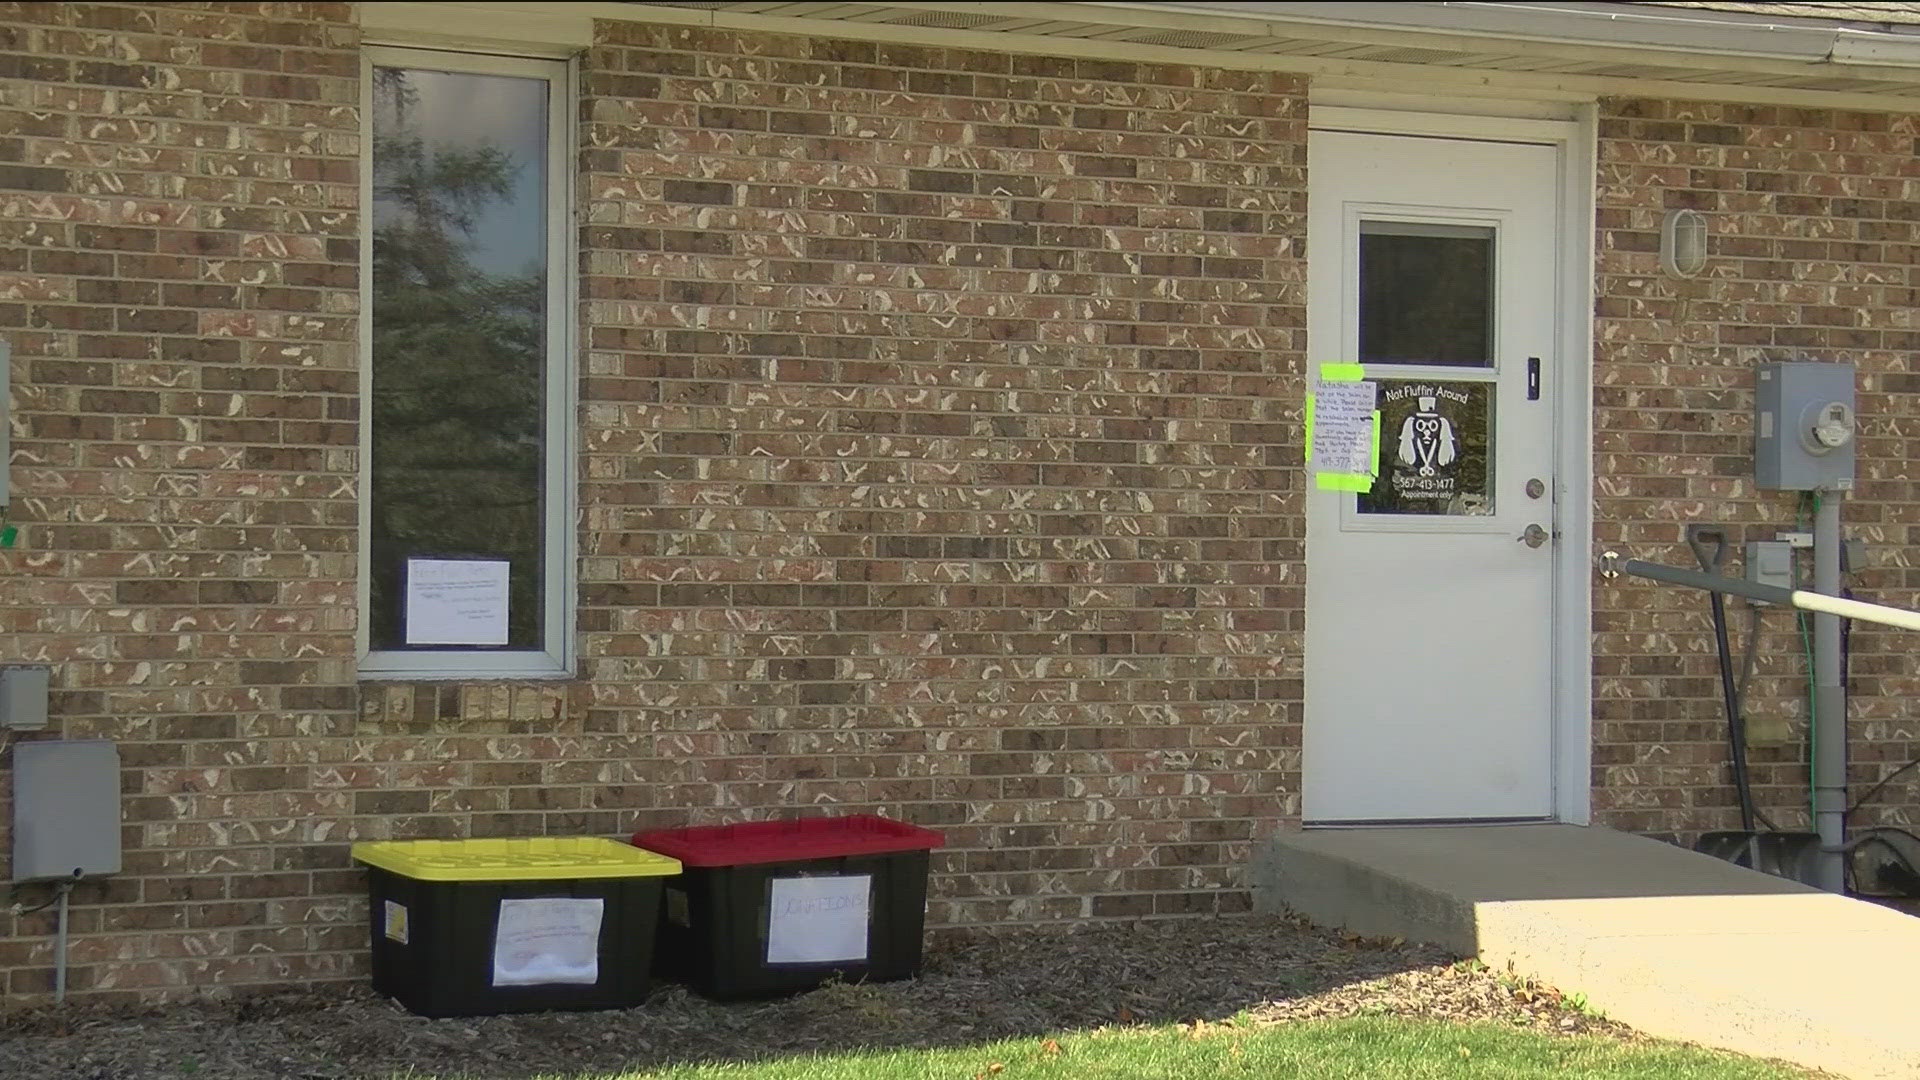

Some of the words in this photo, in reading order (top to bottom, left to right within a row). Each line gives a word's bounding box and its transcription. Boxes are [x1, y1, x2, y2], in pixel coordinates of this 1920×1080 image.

[1385, 389, 1404, 402] Not
[1404, 385, 1434, 398] Fluffin'
[1435, 386, 1469, 404] Around
[1400, 478, 1454, 489] 567-413-1477
[1400, 489, 1439, 500] Appointment
[774, 894, 864, 918] DONATIONS
